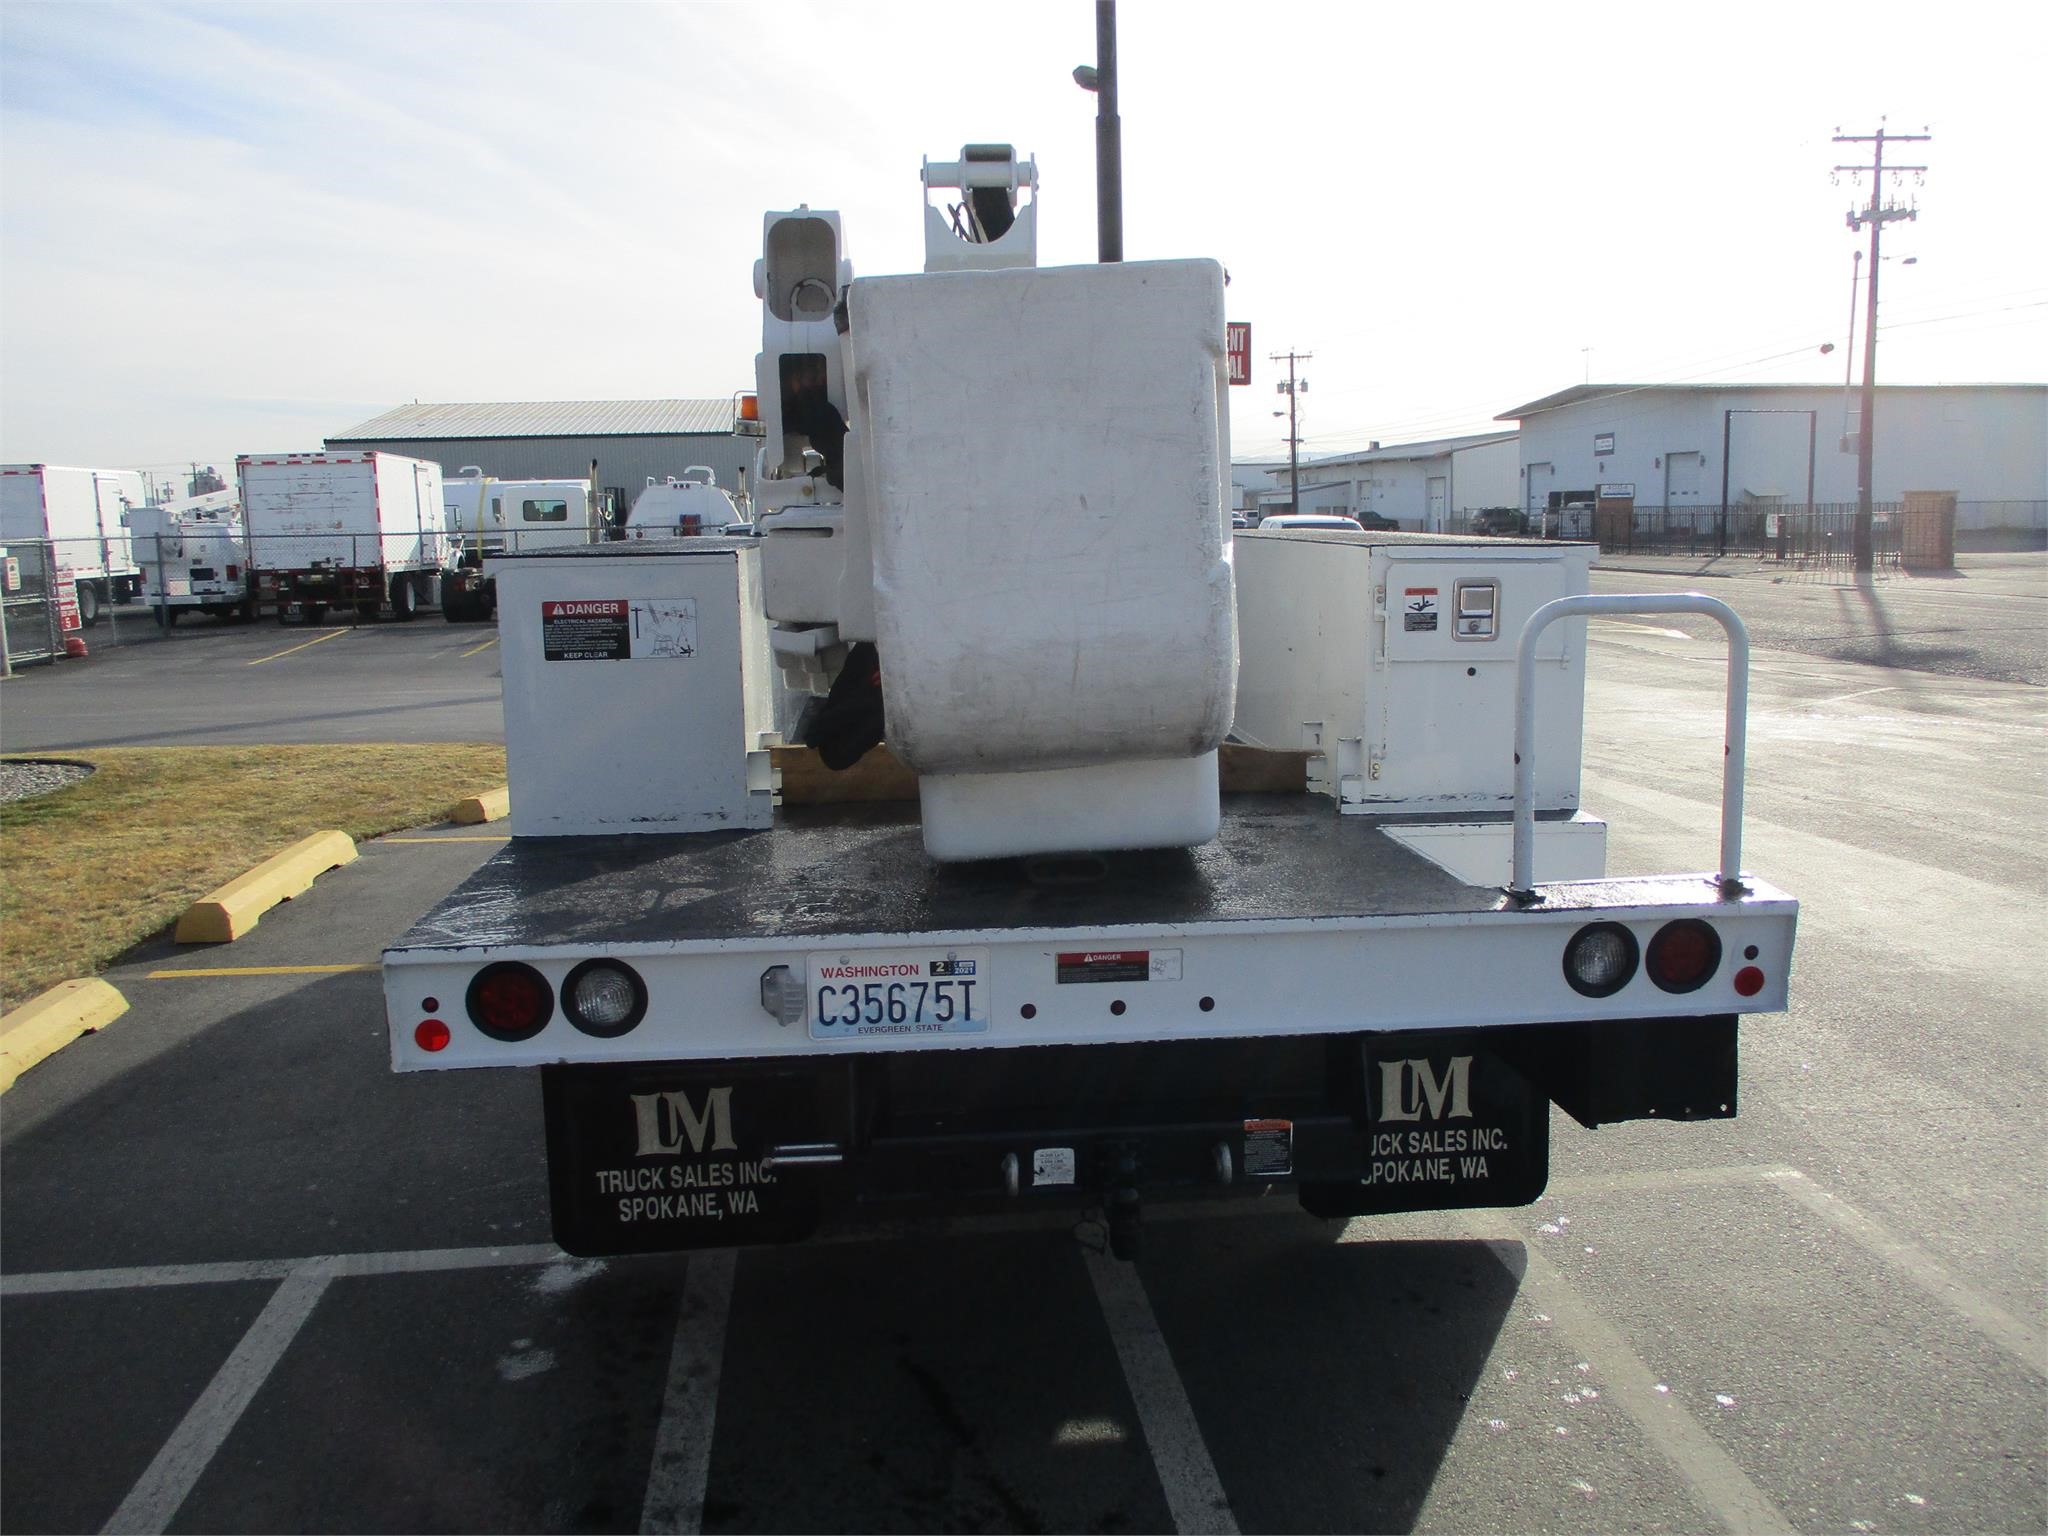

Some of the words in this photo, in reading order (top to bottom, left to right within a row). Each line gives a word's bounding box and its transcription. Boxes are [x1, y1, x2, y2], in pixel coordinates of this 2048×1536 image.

[566, 603, 619, 615] DANGER
[563, 652, 583, 660] KEEP
[584, 651, 608, 659] CLEAR
[935, 961, 945, 972] 2
[1093, 953, 1122, 962] DANGER
[820, 964, 920, 979] WASHINGTON
[818, 980, 977, 1027] C35675T
[858, 1025, 912, 1034] EVERGREEN
[916, 1024, 944, 1032] STATE
[1378, 1055, 1473, 1123] LM
[630, 1085, 738, 1157] LM
[1408, 1129, 1468, 1154] SALES
[1472, 1127, 1508, 1151] INC.
[596, 1167, 664, 1194] TRUCK
[670, 1162, 735, 1188] SALES
[739, 1160, 777, 1184] INC.
[1460, 1156, 1489, 1179] WA
[618, 1193, 724, 1222] SPOKANE,
[727, 1190, 759, 1214] WA
